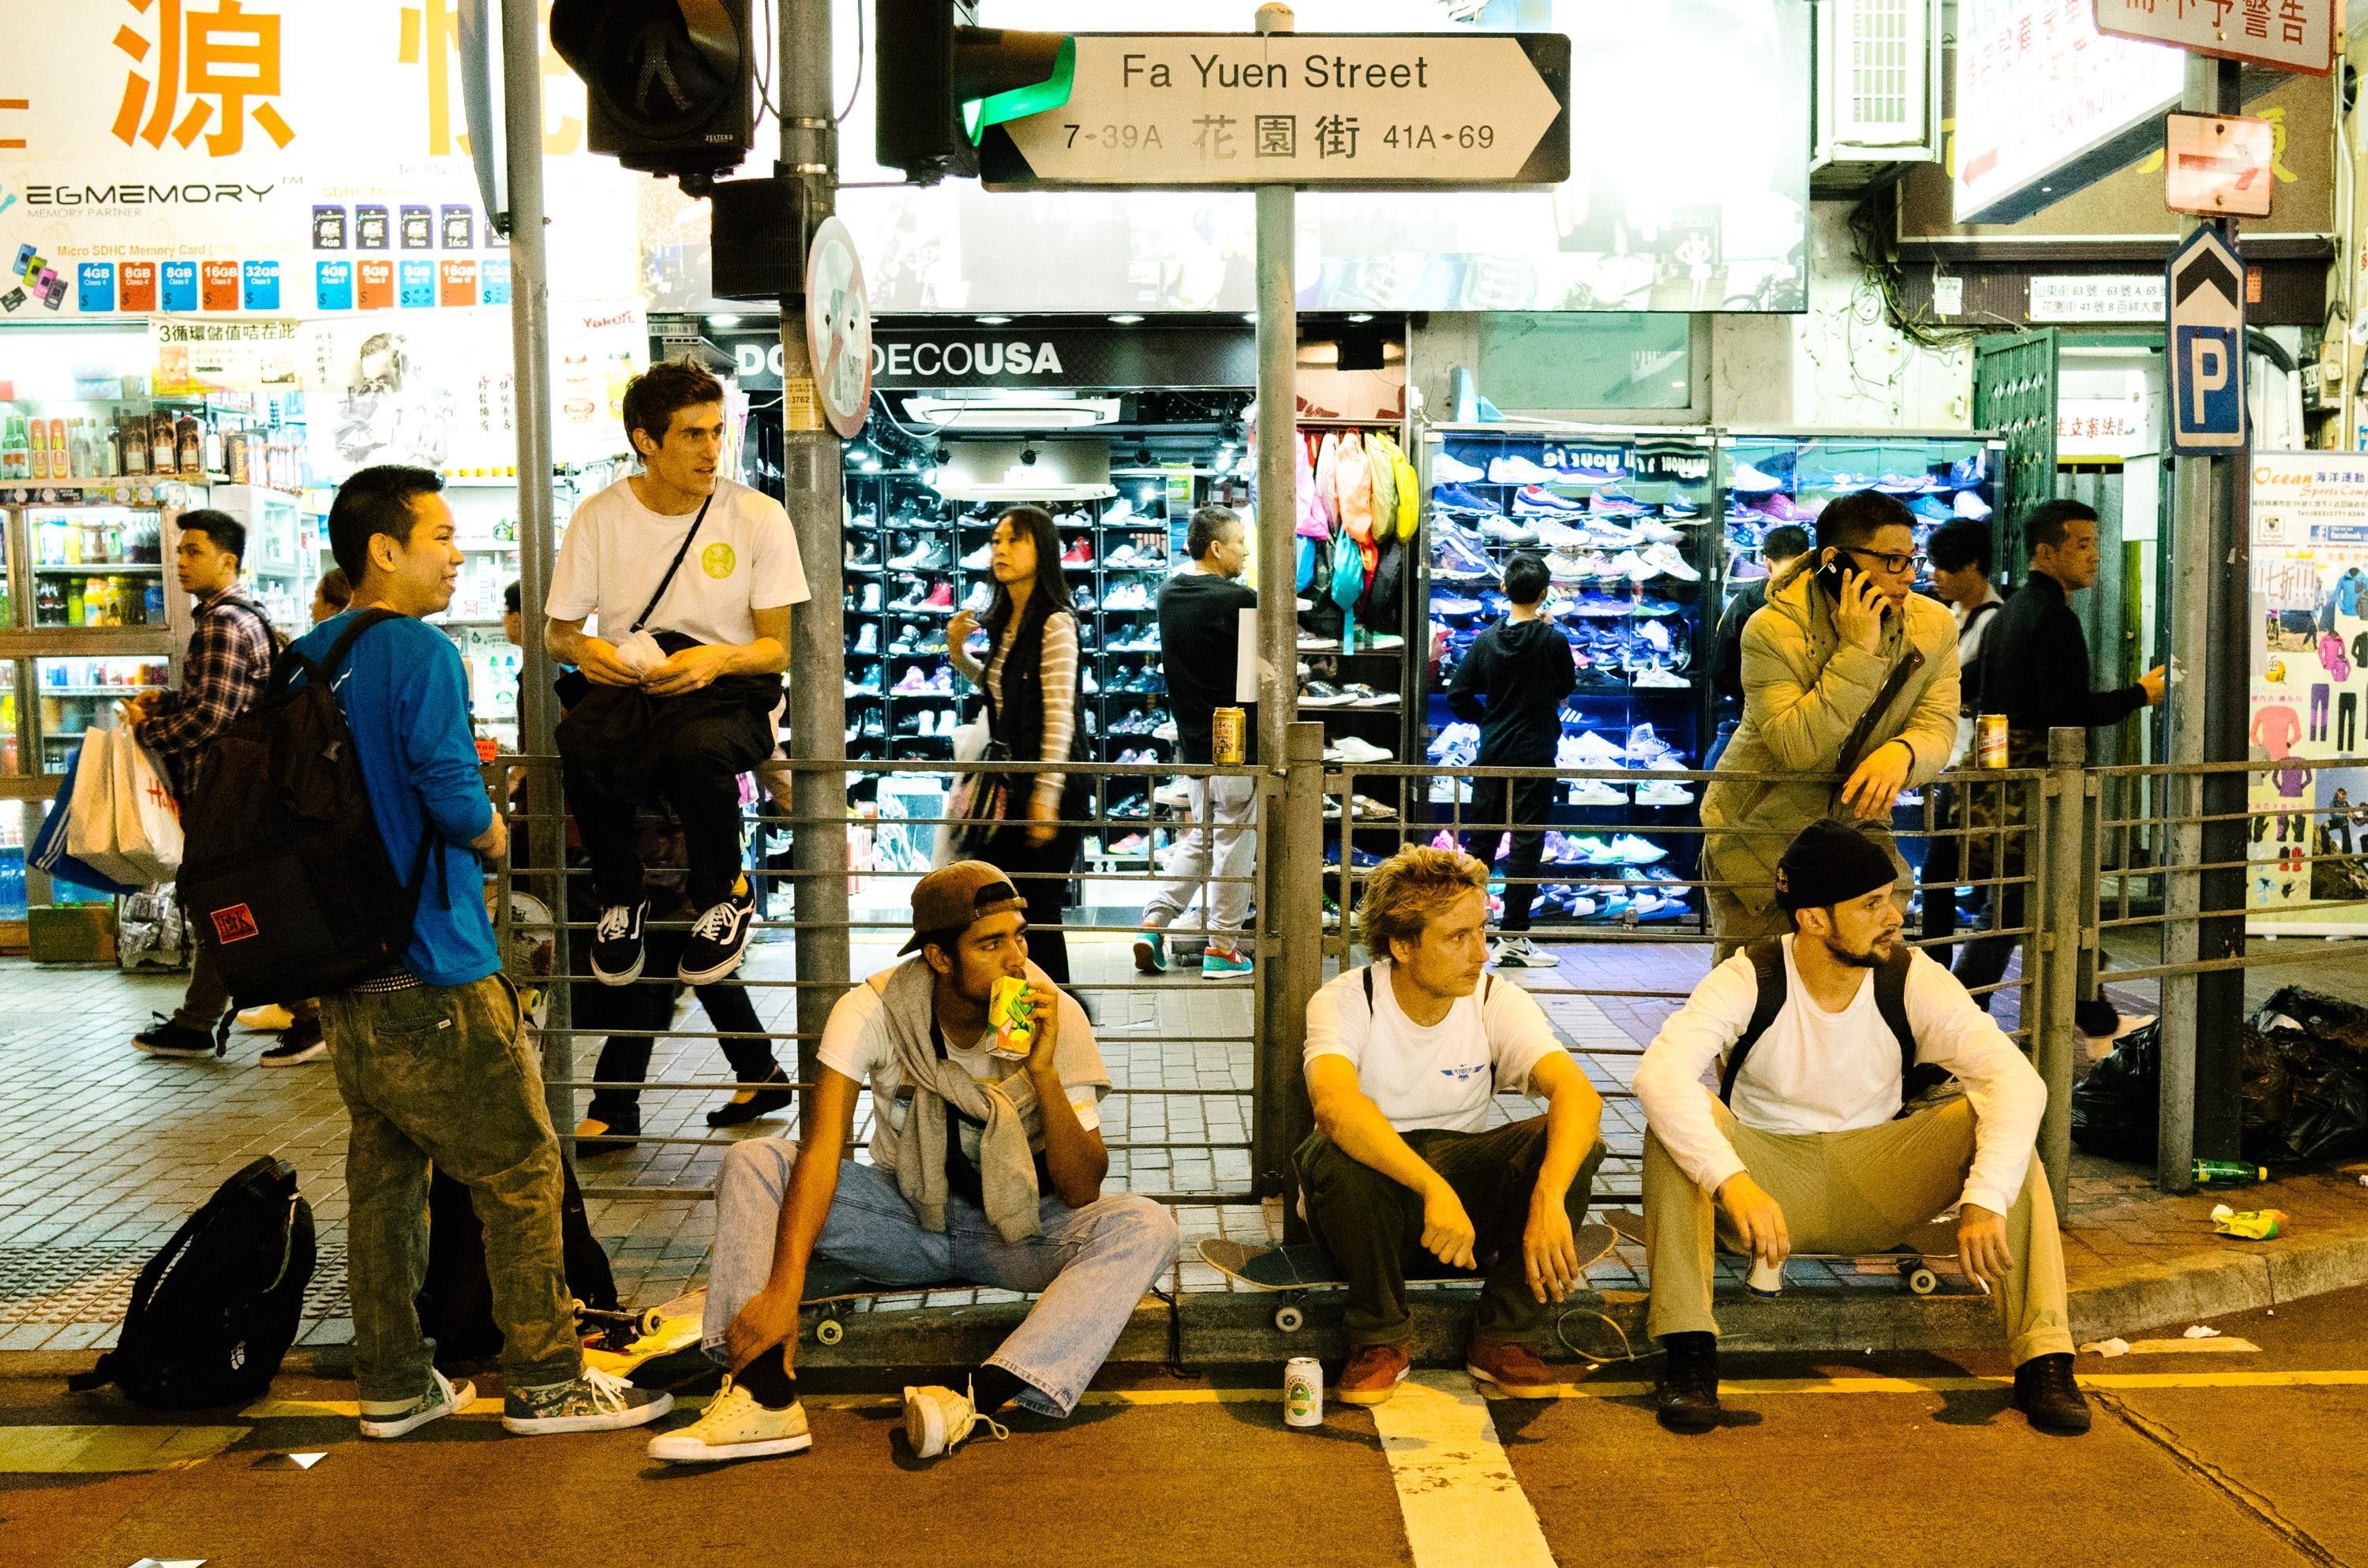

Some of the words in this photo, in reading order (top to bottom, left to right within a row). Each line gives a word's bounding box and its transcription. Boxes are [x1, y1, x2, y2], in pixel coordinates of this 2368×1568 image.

[2125, 0, 2308, 45] 予警告
[111, 0, 297, 158] 源
[1123, 54, 1171, 88] Fa
[1190, 54, 1287, 88] Yuen
[1304, 54, 1428, 88] Street
[1192, 114, 1360, 159] 花園街
[26, 184, 274, 204] EGMEMORY
[27, 208, 83, 218] MEMORY
[88, 208, 141, 217] PARTNER
[57, 245, 89, 256] Micro
[92, 245, 126, 256] SDHC
[129, 245, 175, 257] Memory
[178, 245, 205, 255] Card
[83, 268, 110, 279] 4GB
[204, 267, 238, 278] 16GB
[245, 266, 279, 277] 32GB
[2073, 286, 2083, 295] 63
[2108, 286, 2118, 295] 63
[2146, 286, 2156, 295] 65
[2191, 338, 2228, 425] P
[2253, 467, 2312, 485] Ocean
